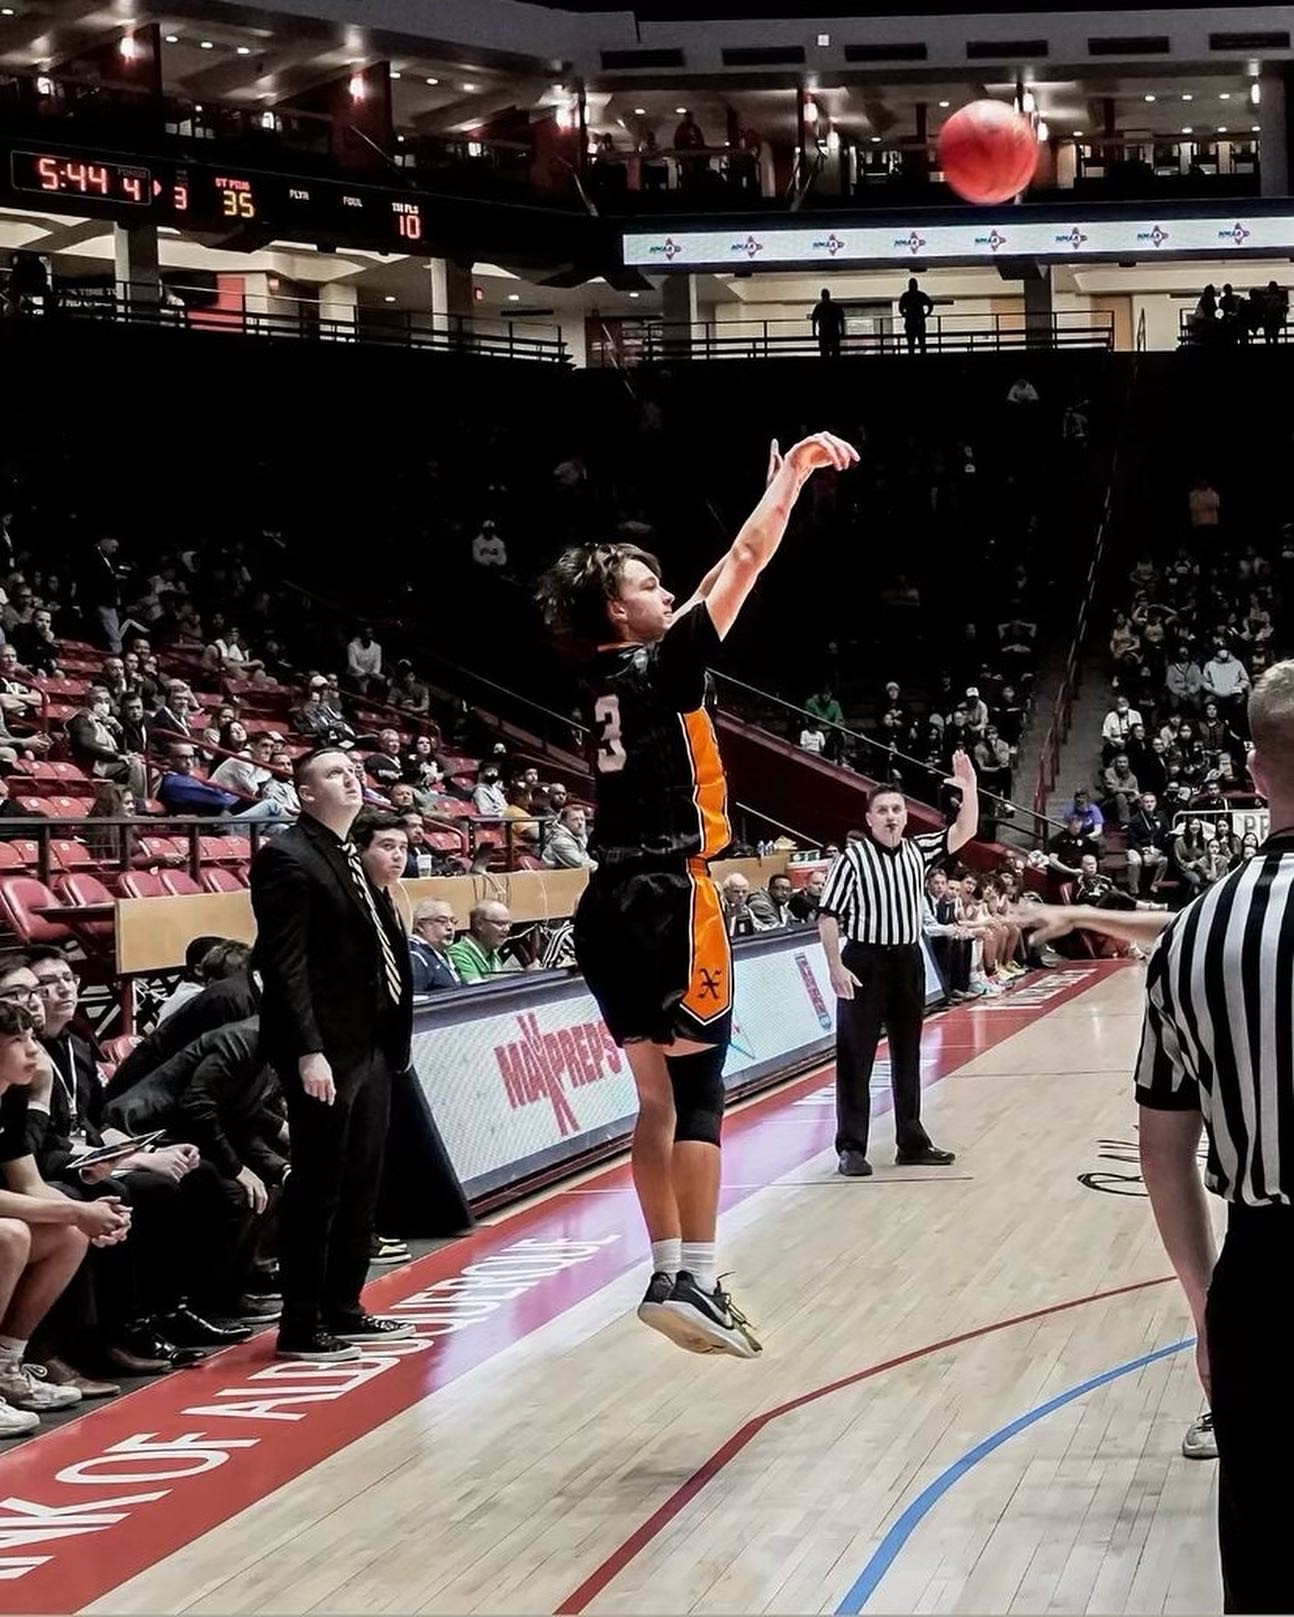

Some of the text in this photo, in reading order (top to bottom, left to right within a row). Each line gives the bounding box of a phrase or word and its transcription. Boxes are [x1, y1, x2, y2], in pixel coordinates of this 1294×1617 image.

[38, 157, 108, 195] 5:44
[123, 177, 141, 201] 4
[174, 186, 188, 210] 3
[223, 190, 255, 218] 35
[400, 214, 420, 239] 10
[55, 1432, 261, 1484] OF
